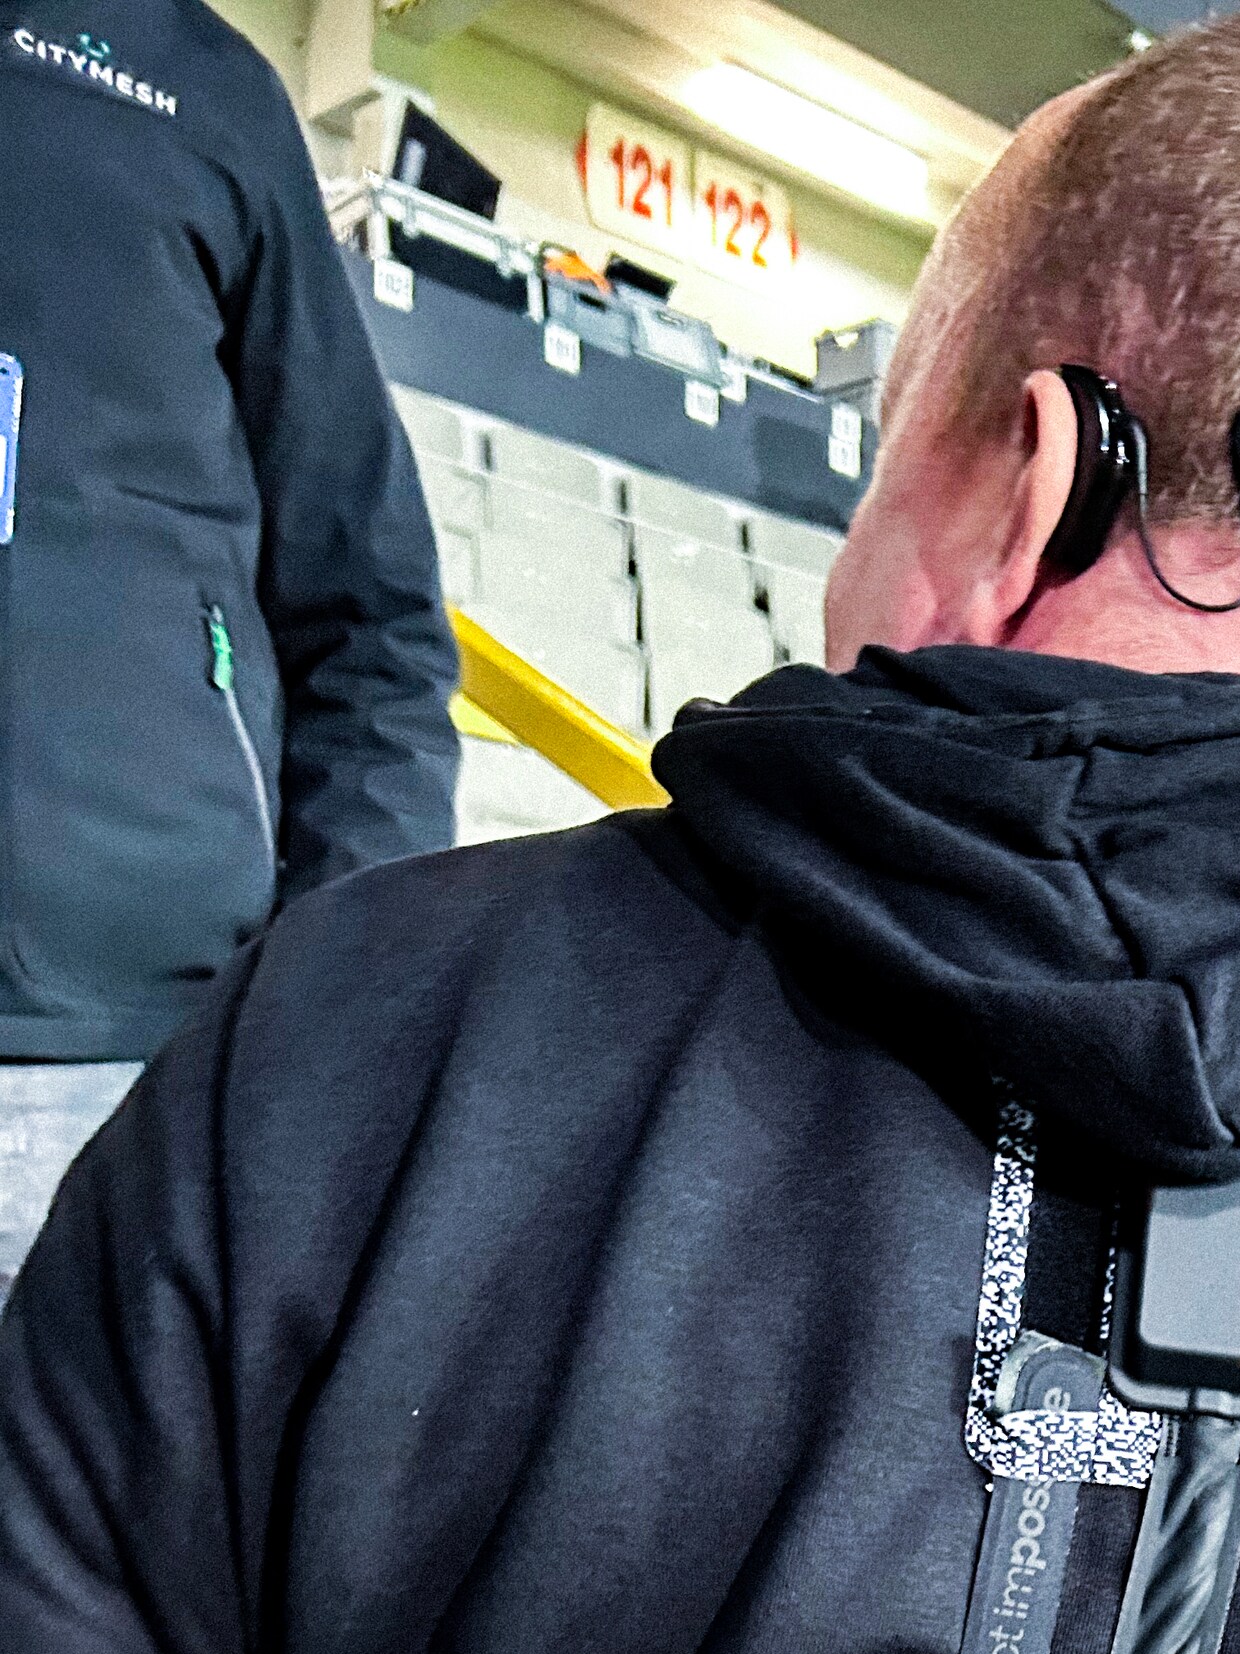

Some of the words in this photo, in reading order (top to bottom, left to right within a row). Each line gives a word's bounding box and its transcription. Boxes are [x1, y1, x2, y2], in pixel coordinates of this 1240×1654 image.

[14, 28, 177, 115] CITYMESH
[608, 136, 671, 228] 121
[704, 181, 771, 268] 122
